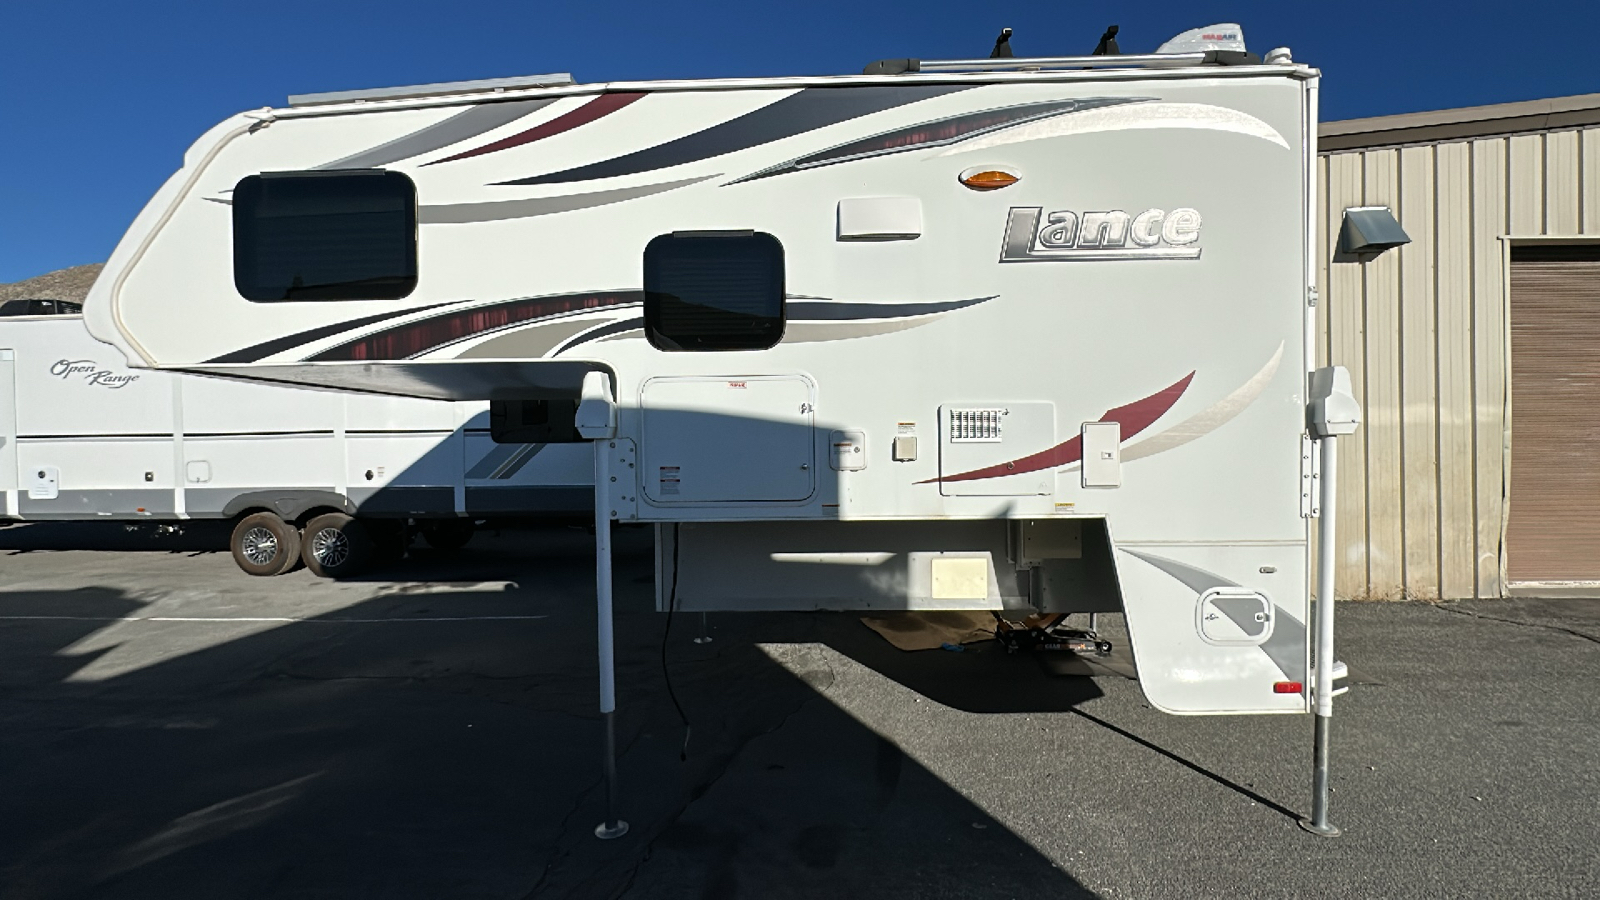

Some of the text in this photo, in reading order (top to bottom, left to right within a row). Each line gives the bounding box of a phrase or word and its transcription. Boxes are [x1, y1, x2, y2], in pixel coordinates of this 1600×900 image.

[999, 206, 1203, 263] Lance
[50, 359, 97, 379] Open
[84, 370, 140, 389] Range
